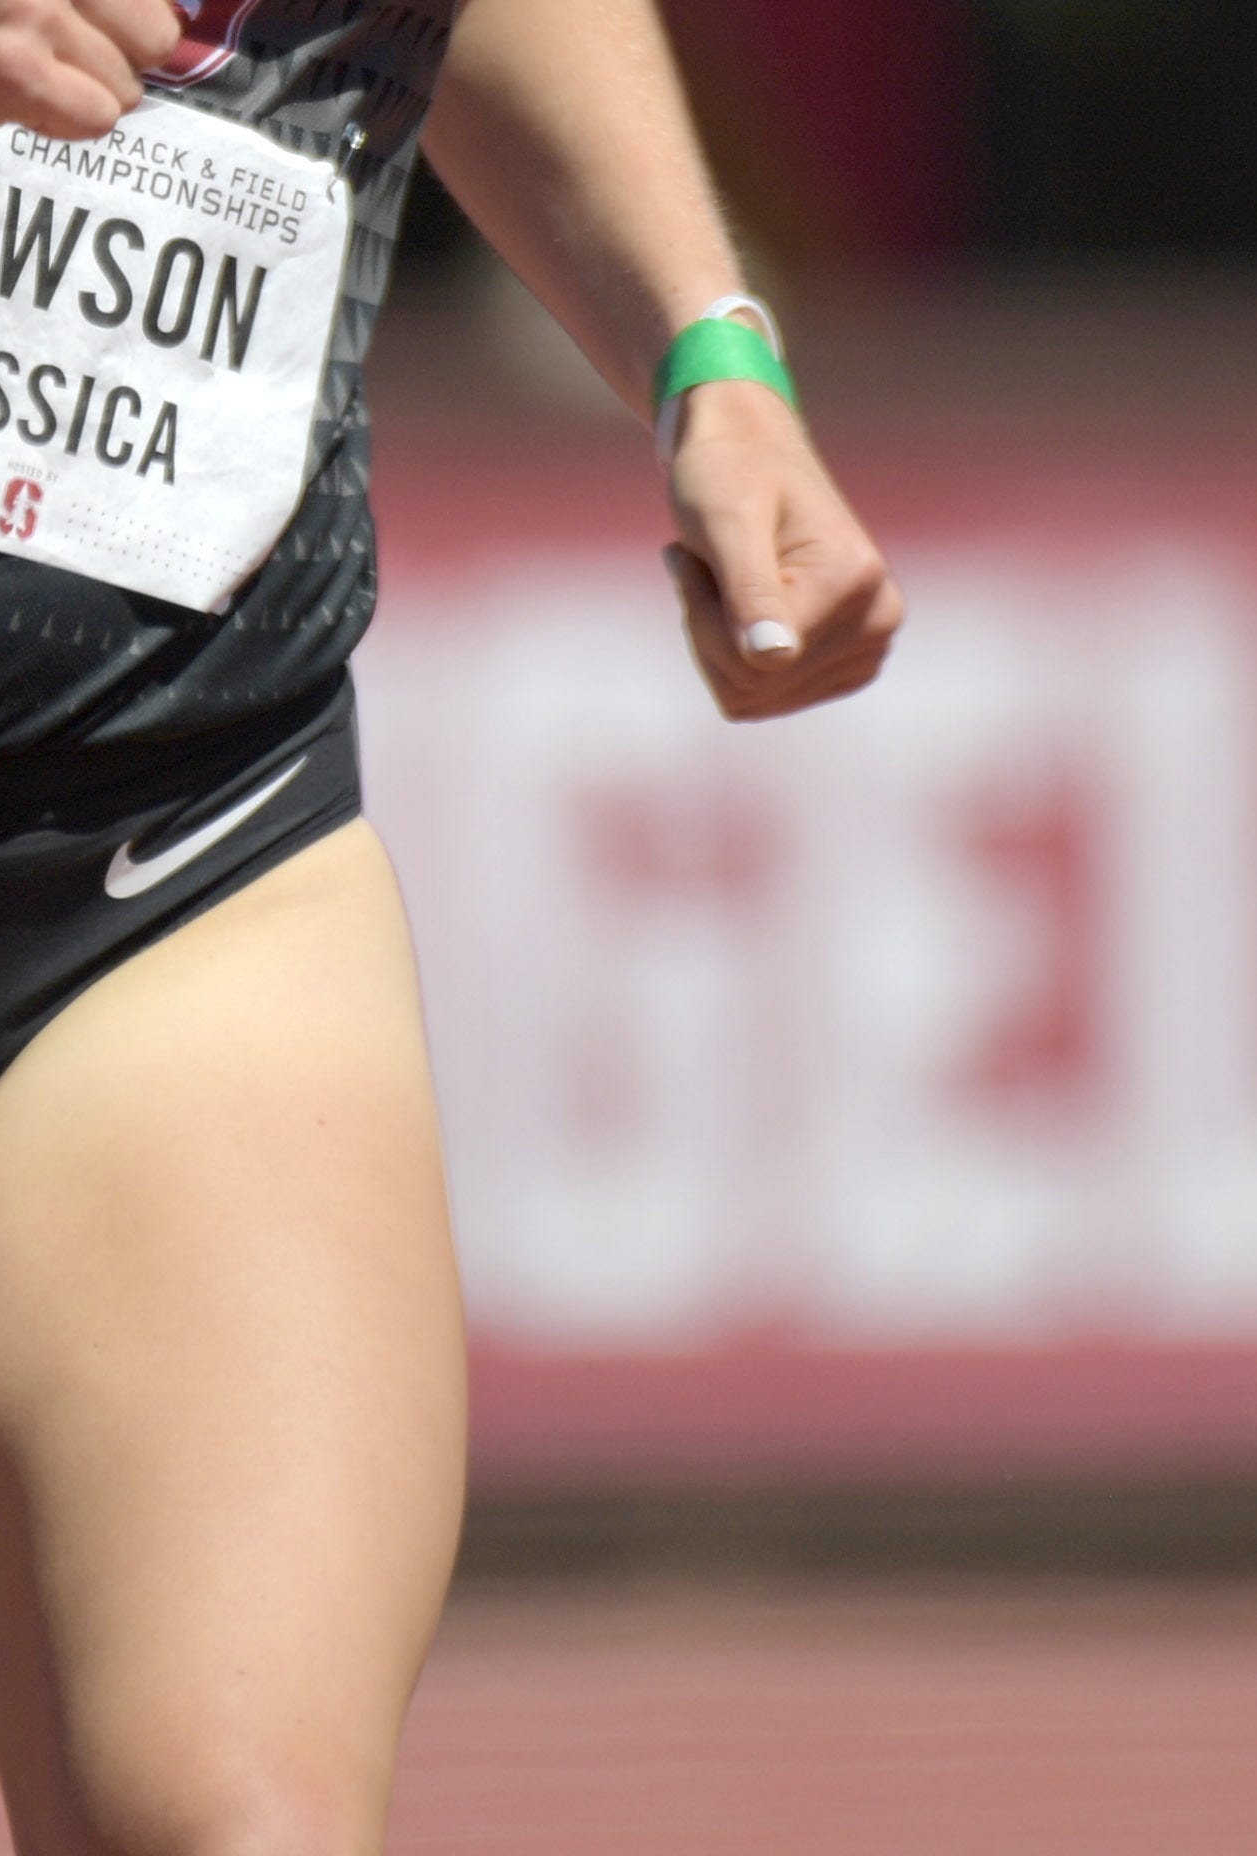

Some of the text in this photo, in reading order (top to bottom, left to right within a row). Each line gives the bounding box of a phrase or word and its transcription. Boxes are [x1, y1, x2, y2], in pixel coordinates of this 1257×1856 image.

[10, 127, 301, 245] CHAMPIONSHIPS
[93, 128, 307, 212] RACK & FIELD
